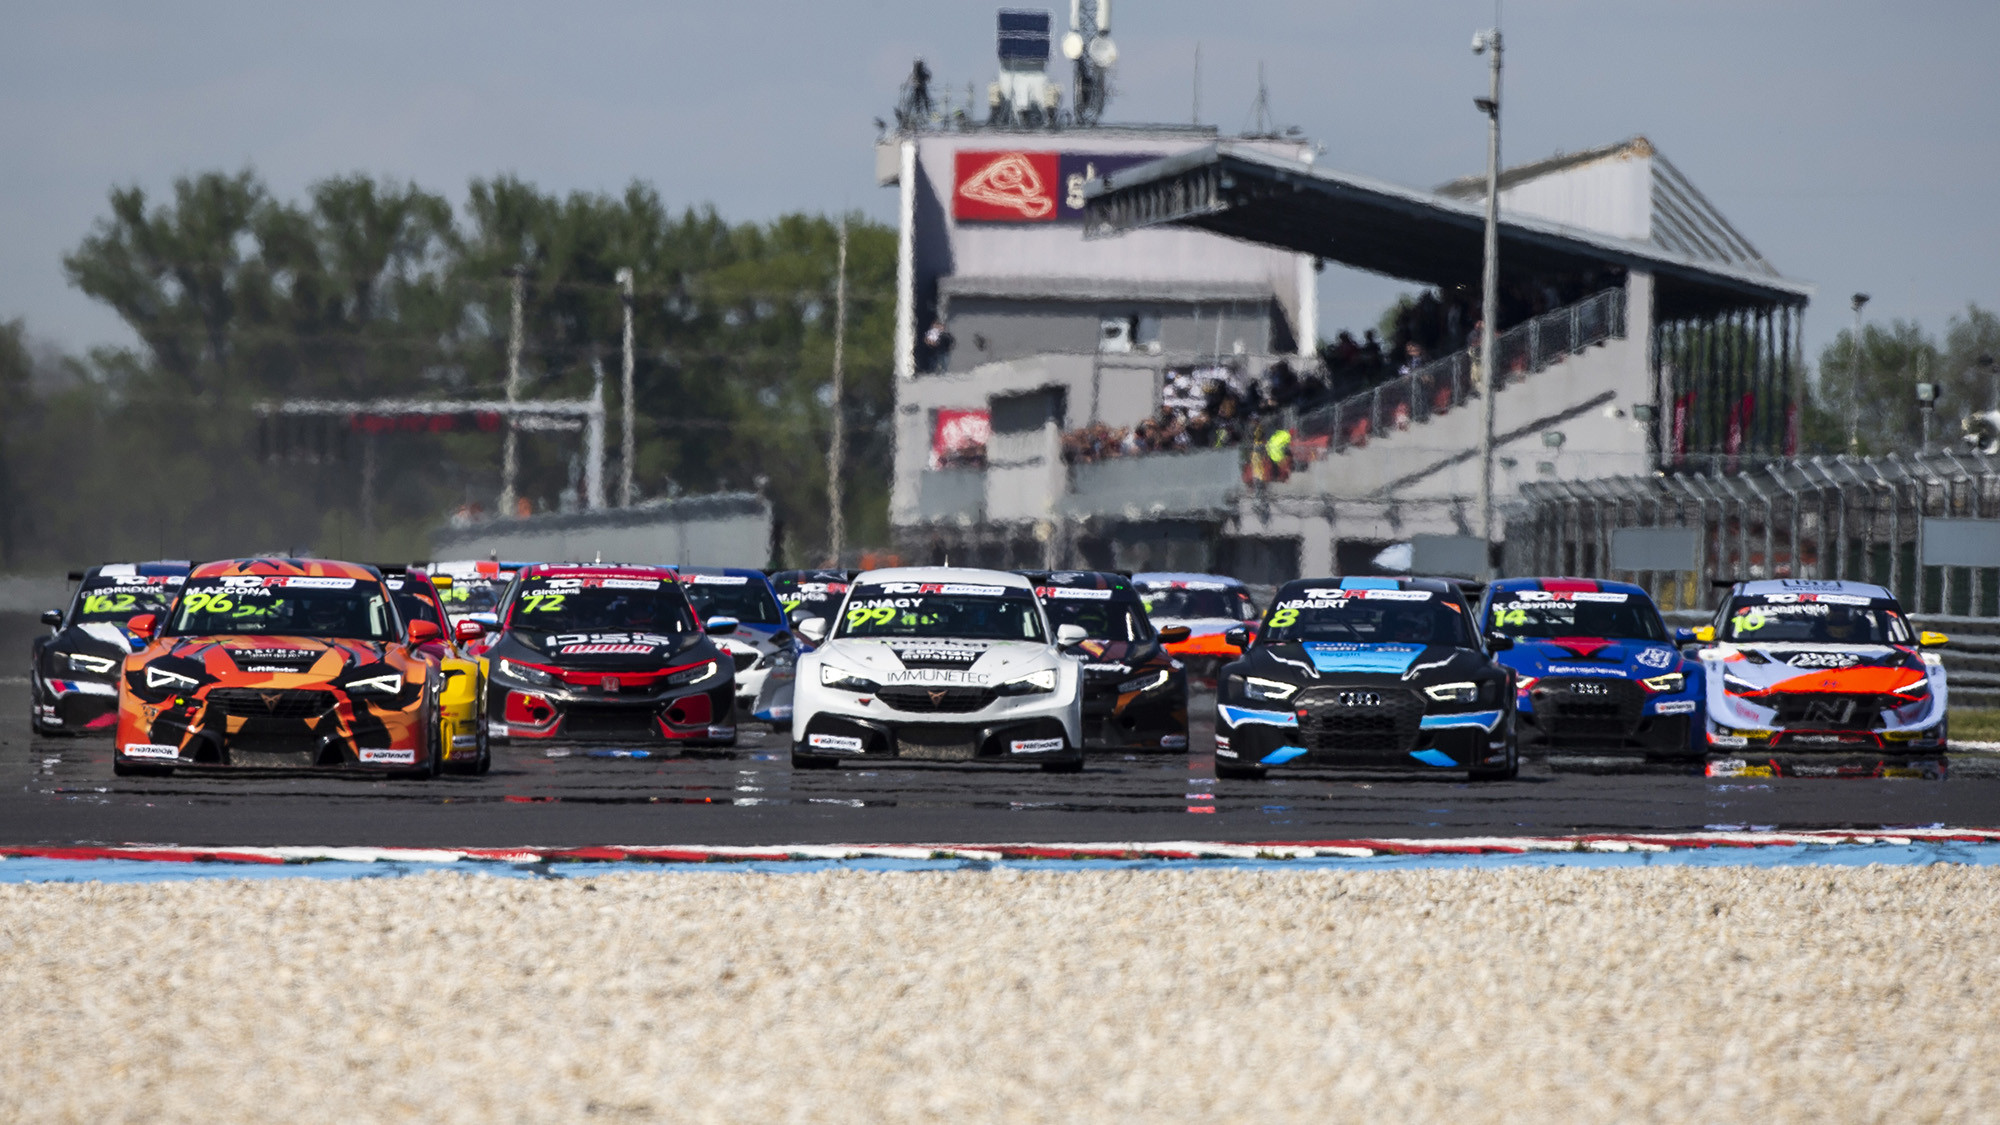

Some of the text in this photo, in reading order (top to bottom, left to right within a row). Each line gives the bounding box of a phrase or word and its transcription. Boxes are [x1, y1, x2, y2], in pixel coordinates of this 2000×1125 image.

[112, 576, 168, 585] TCR
[219, 576, 353, 588] TCR Europe
[545, 579, 604, 588] TCR
[185, 586, 272, 597] M.AZCONA
[880, 583, 945, 595] TCR
[1303, 588, 1367, 599] TCR
[1515, 591, 1574, 601] TCR
[1763, 593, 1818, 603] TCR
[83, 594, 136, 615] 162
[183, 593, 233, 613] 96
[523, 594, 565, 614] 72
[849, 598, 923, 611] D.NAGY
[847, 607, 896, 627] 99
[1269, 608, 1300, 628] 8
[1494, 610, 1528, 627] 14
[1732, 614, 1766, 632] 10
[887, 670, 990, 685] IMMUNETEC
